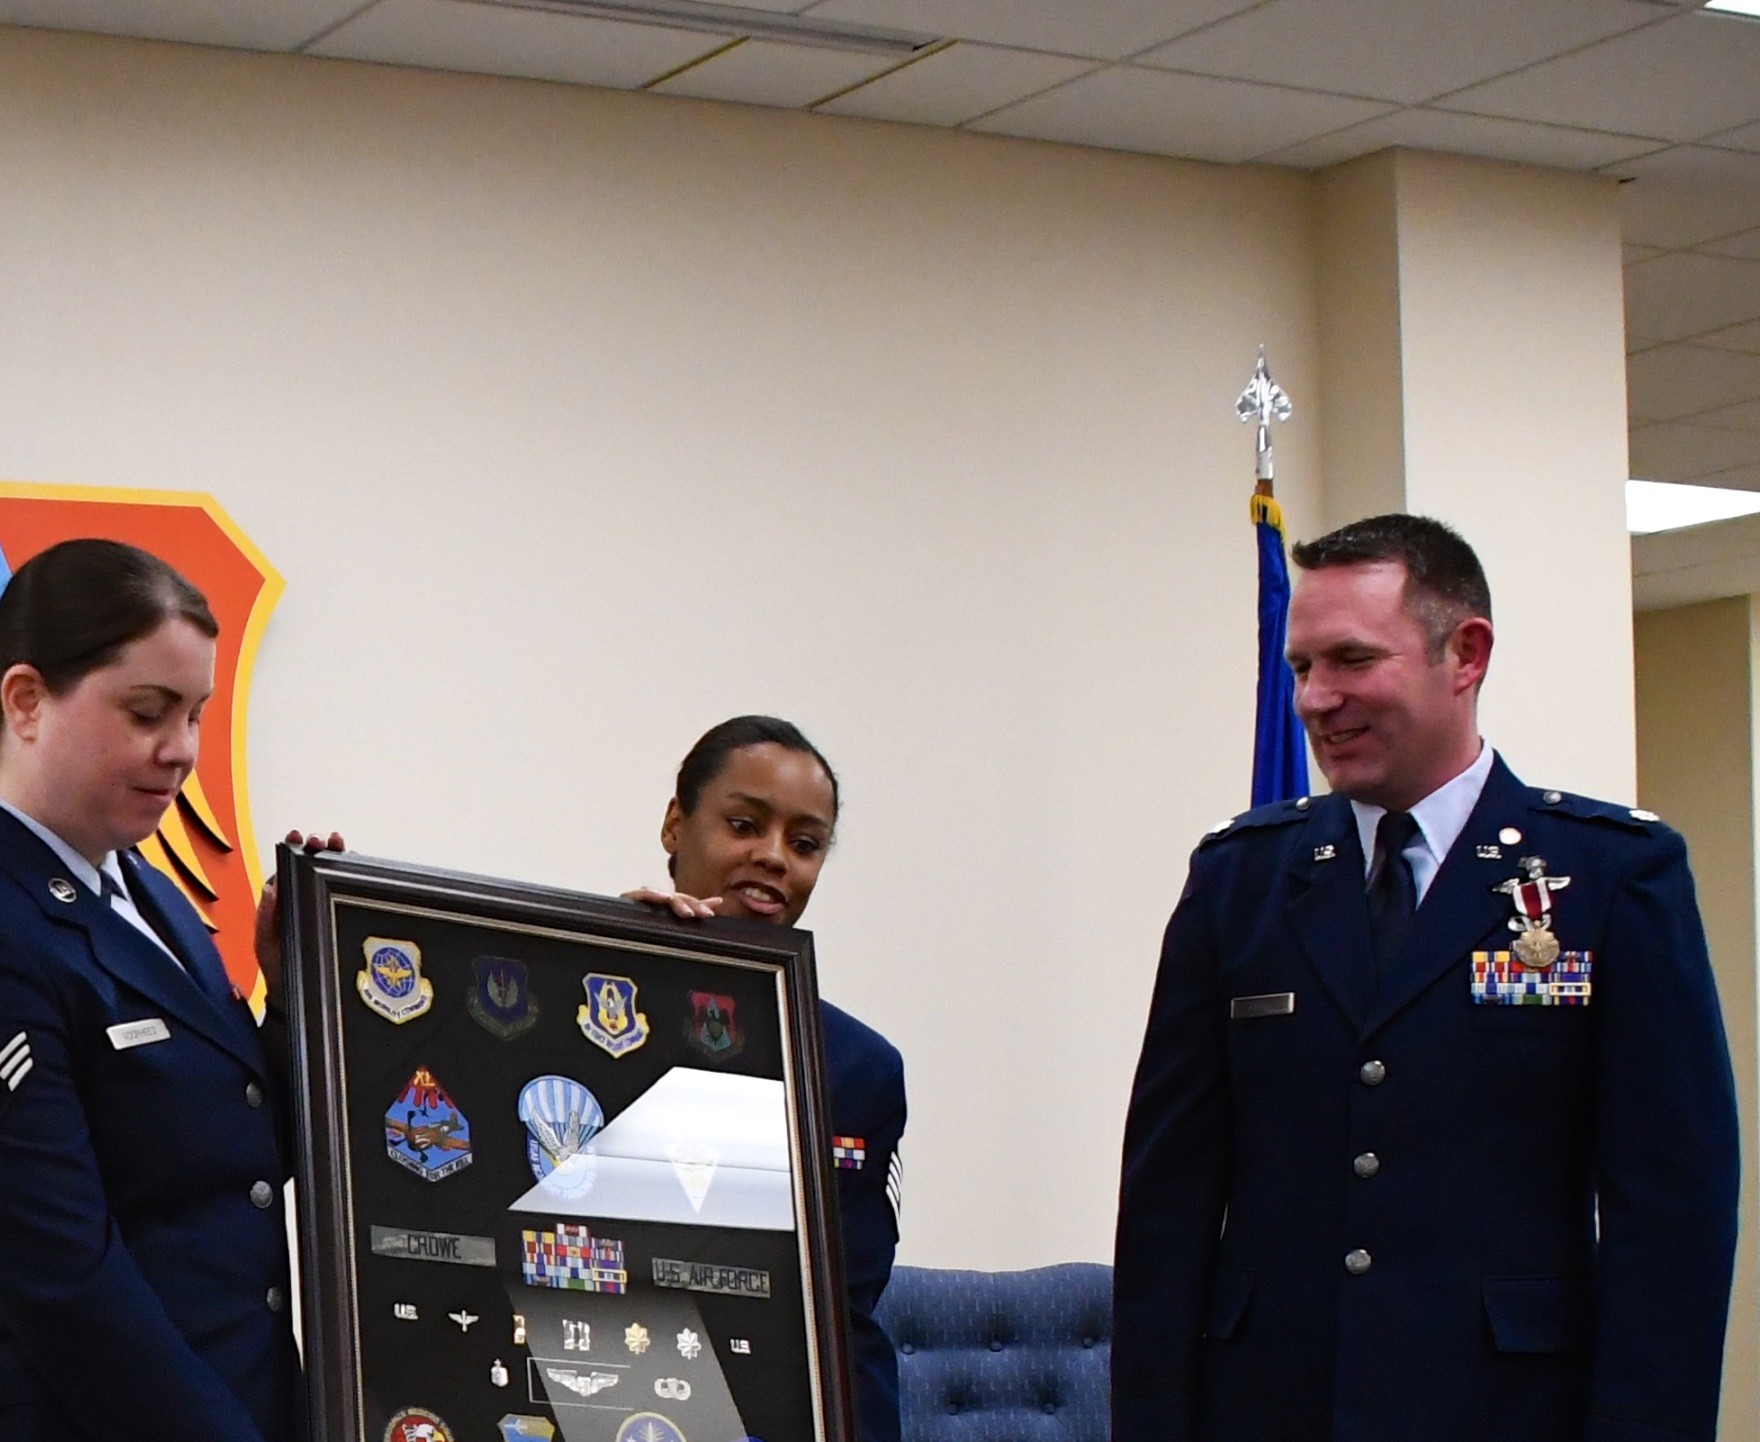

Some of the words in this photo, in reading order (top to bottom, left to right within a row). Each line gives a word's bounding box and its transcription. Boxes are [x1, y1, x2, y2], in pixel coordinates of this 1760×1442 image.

[414, 1070, 436, 1087] XL
[407, 1234, 462, 1259] CROWE
[689, 1265, 714, 1288] AIR
[718, 1268, 769, 1294] FORCE
